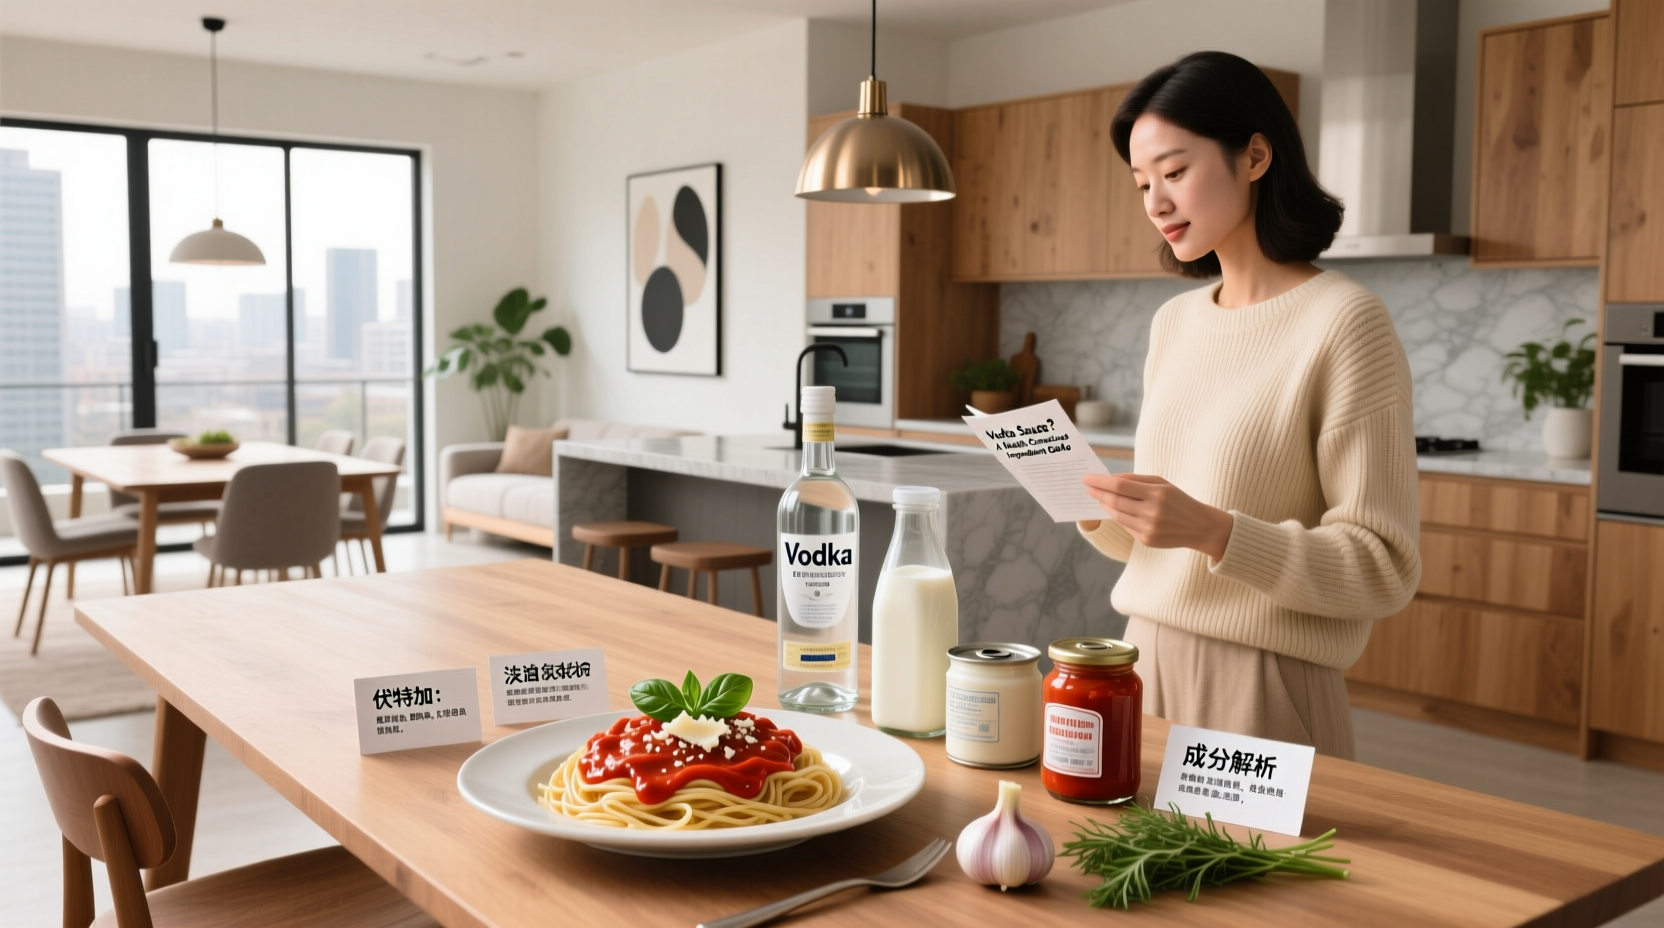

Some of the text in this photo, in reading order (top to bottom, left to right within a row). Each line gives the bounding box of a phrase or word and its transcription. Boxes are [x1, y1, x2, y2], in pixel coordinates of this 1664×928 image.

[784, 541, 852, 567] Vodka
[1182, 742, 1277, 780] 成分解析
